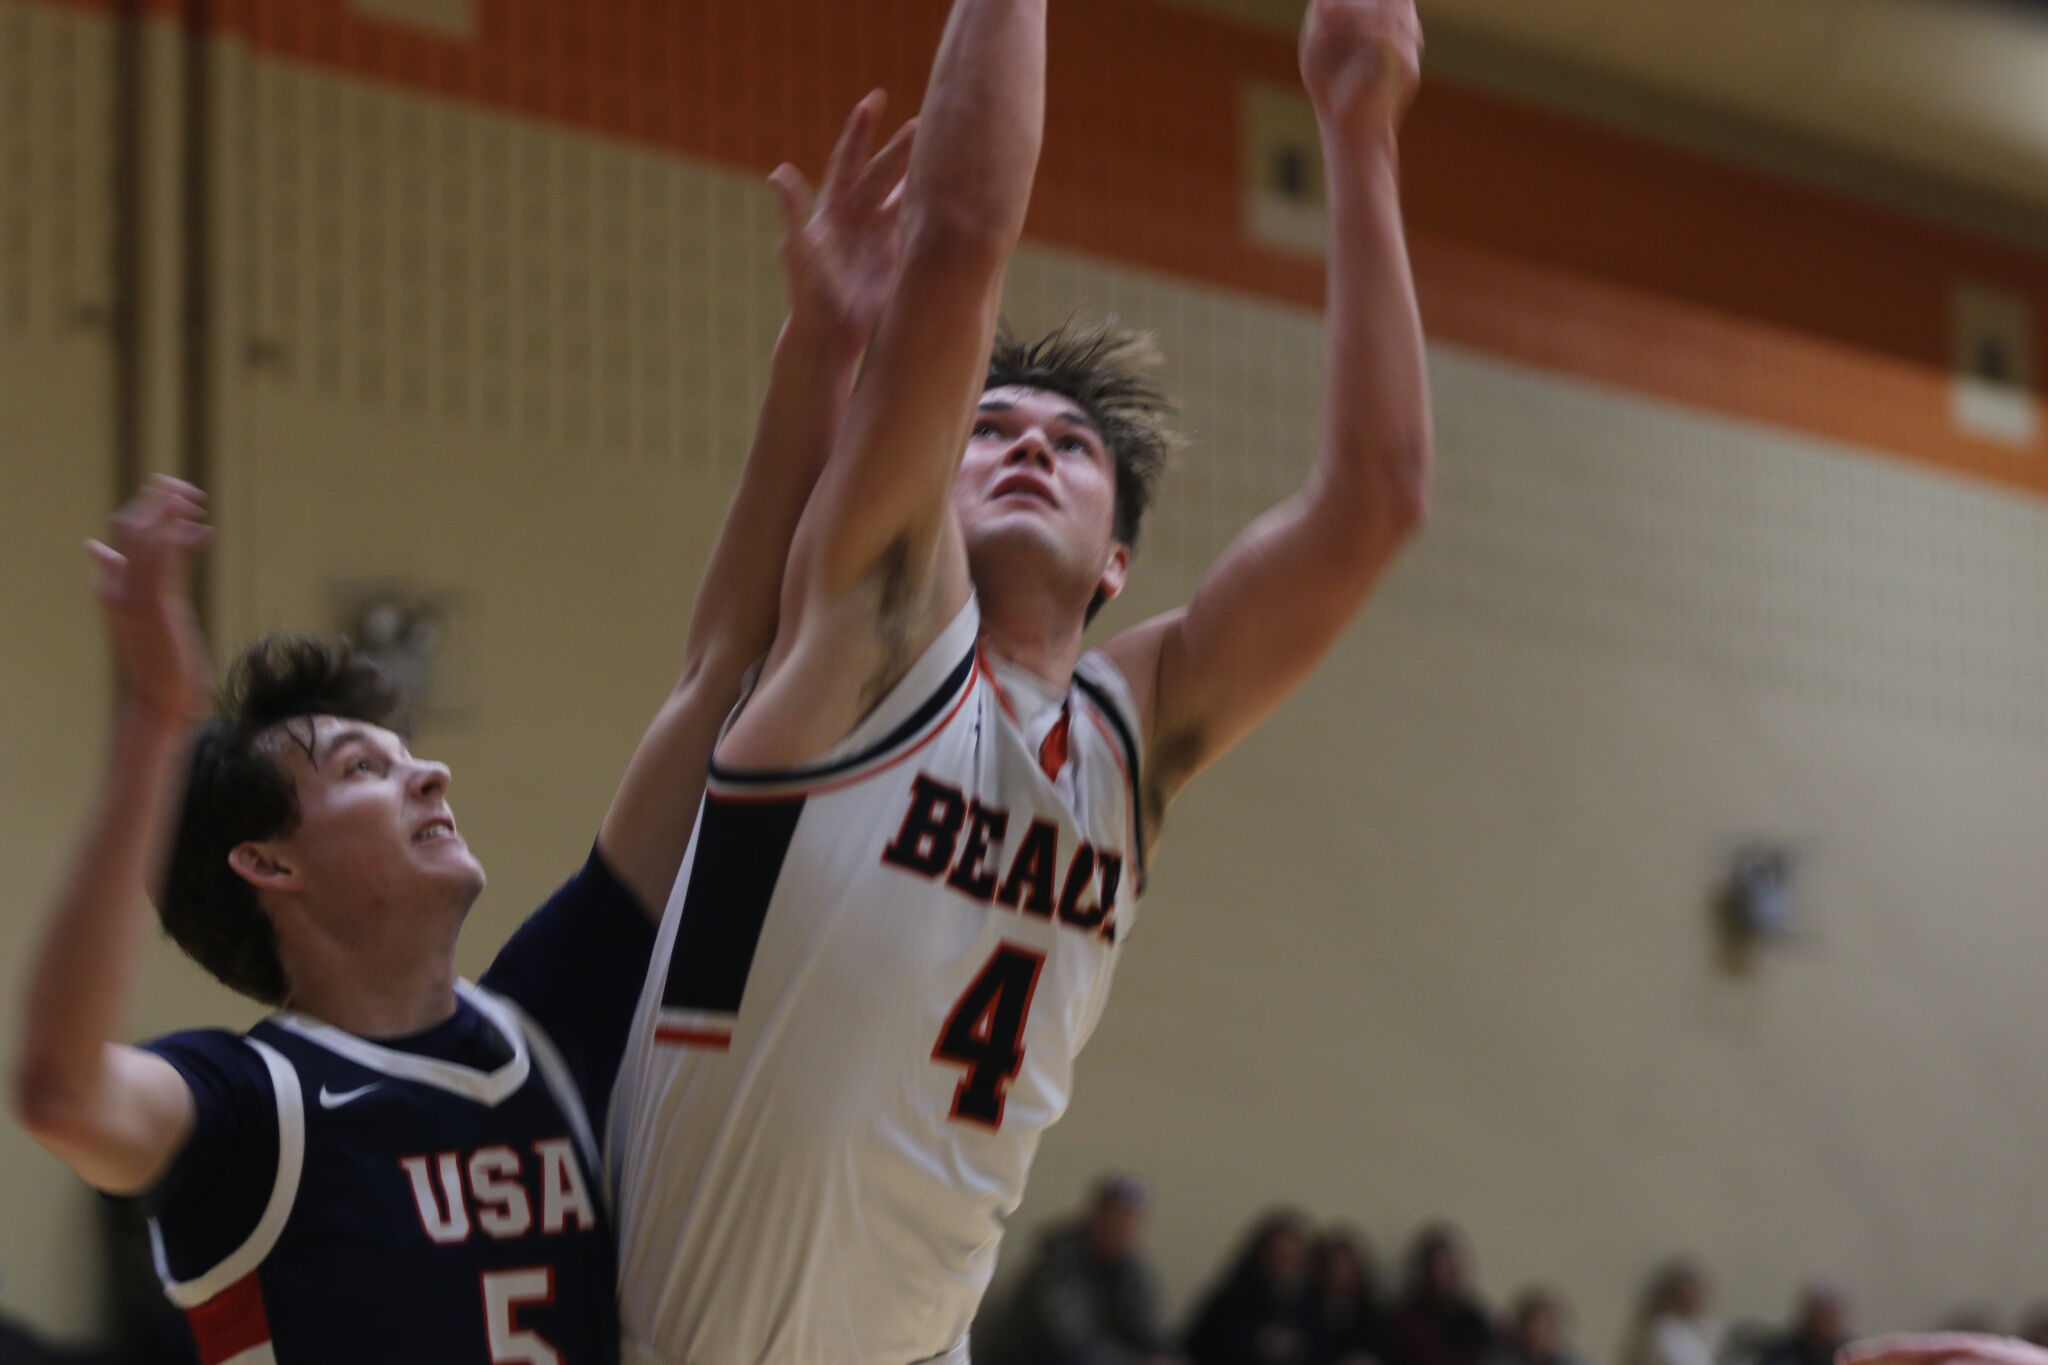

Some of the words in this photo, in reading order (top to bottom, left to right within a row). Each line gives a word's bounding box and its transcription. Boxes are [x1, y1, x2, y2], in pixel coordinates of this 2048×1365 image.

[930, 940, 1046, 1131] 4
[398, 1137, 595, 1244] USA
[480, 1265, 566, 1365] 5
